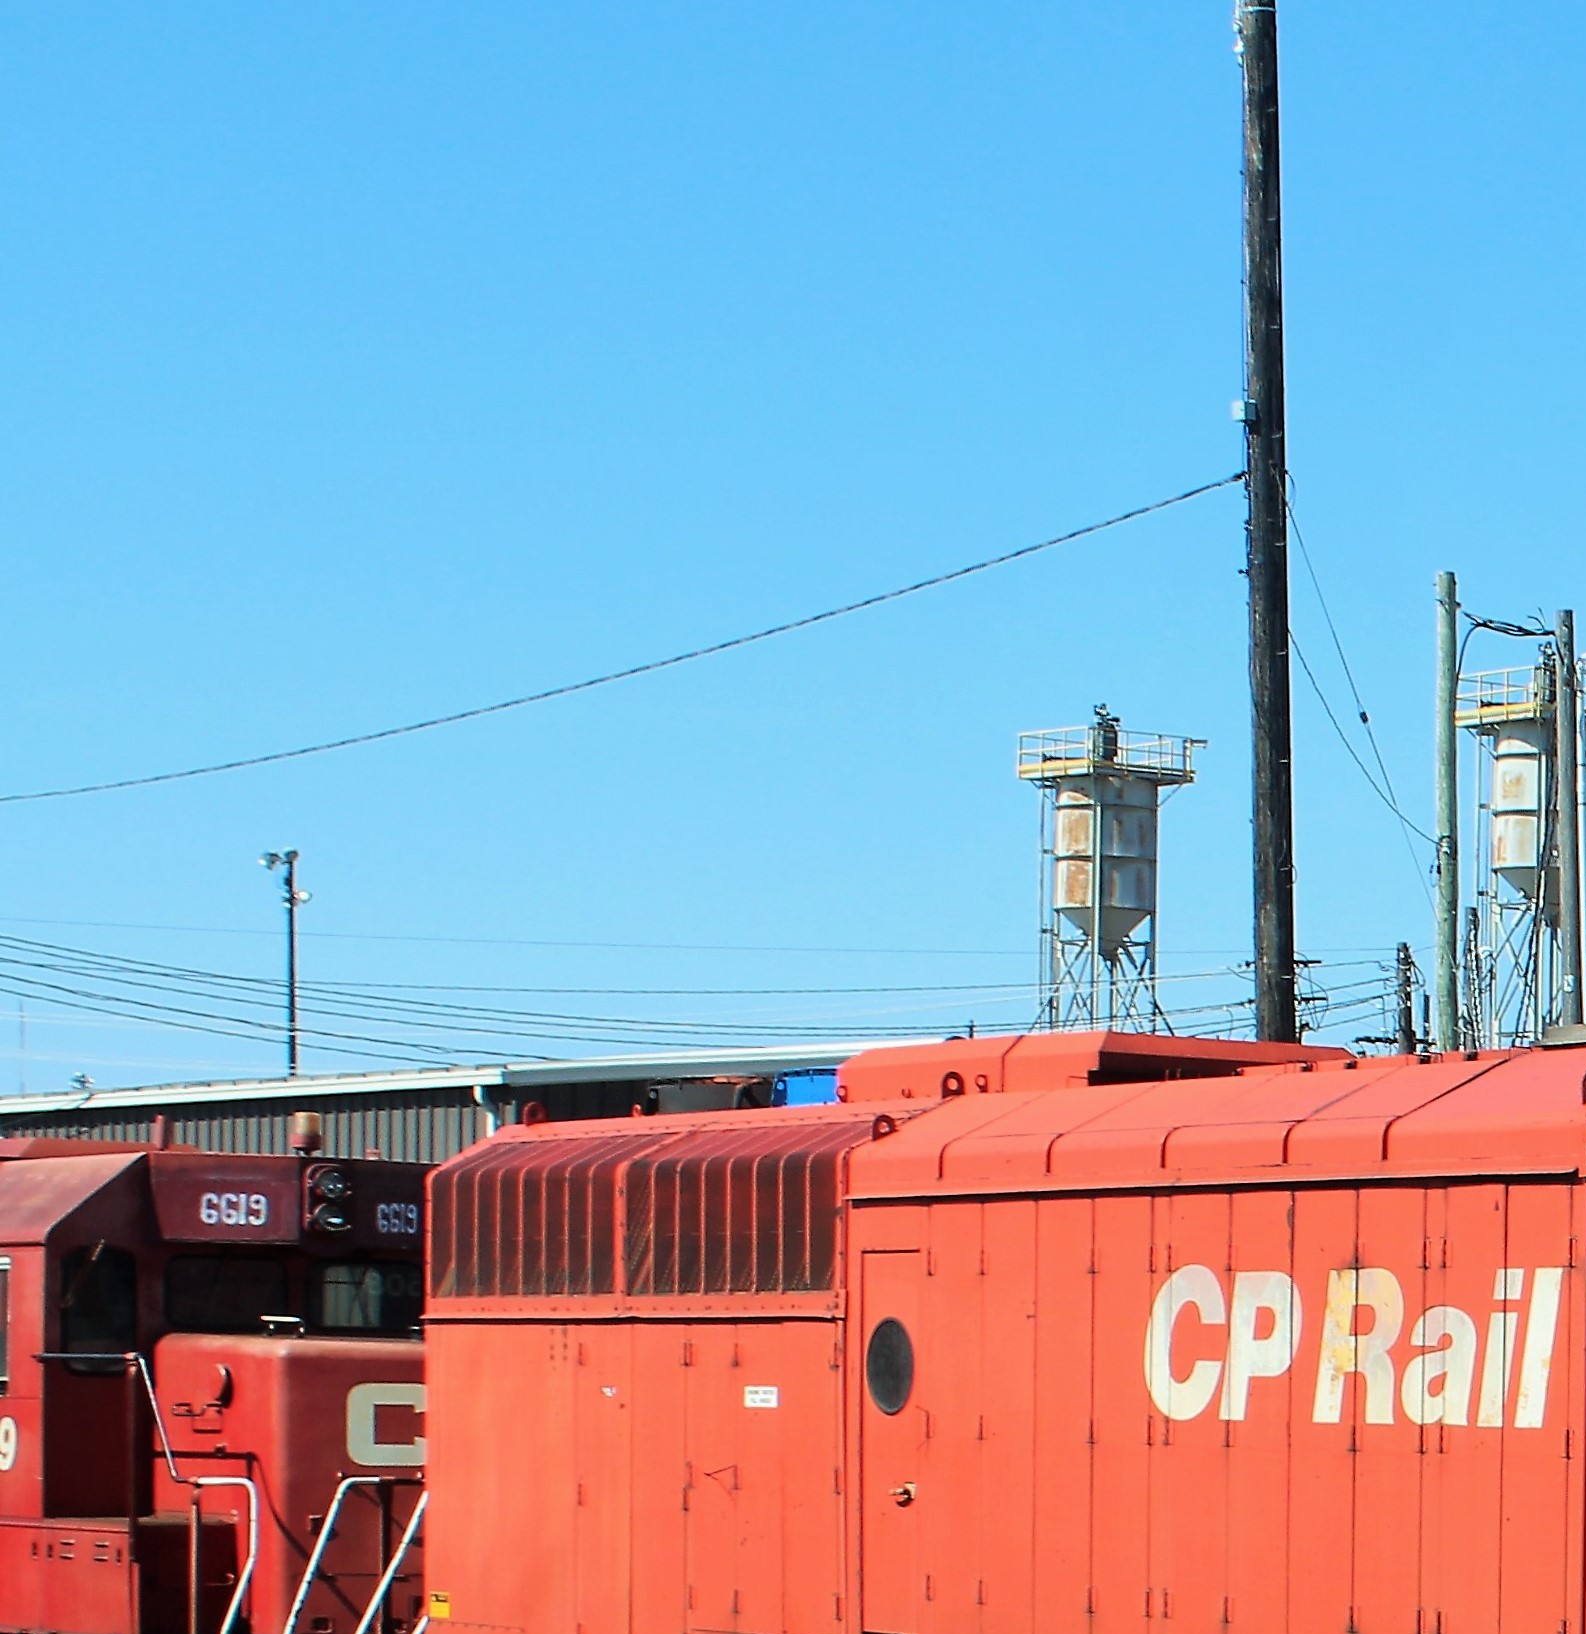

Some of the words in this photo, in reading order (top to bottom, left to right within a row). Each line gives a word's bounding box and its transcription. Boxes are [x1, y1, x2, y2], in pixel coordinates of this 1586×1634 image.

[200, 1192, 268, 1226] 6619
[376, 1203, 418, 1234] 6619
[1143, 1263, 1303, 1422] CP
[1311, 1266, 1565, 1429] Rail
